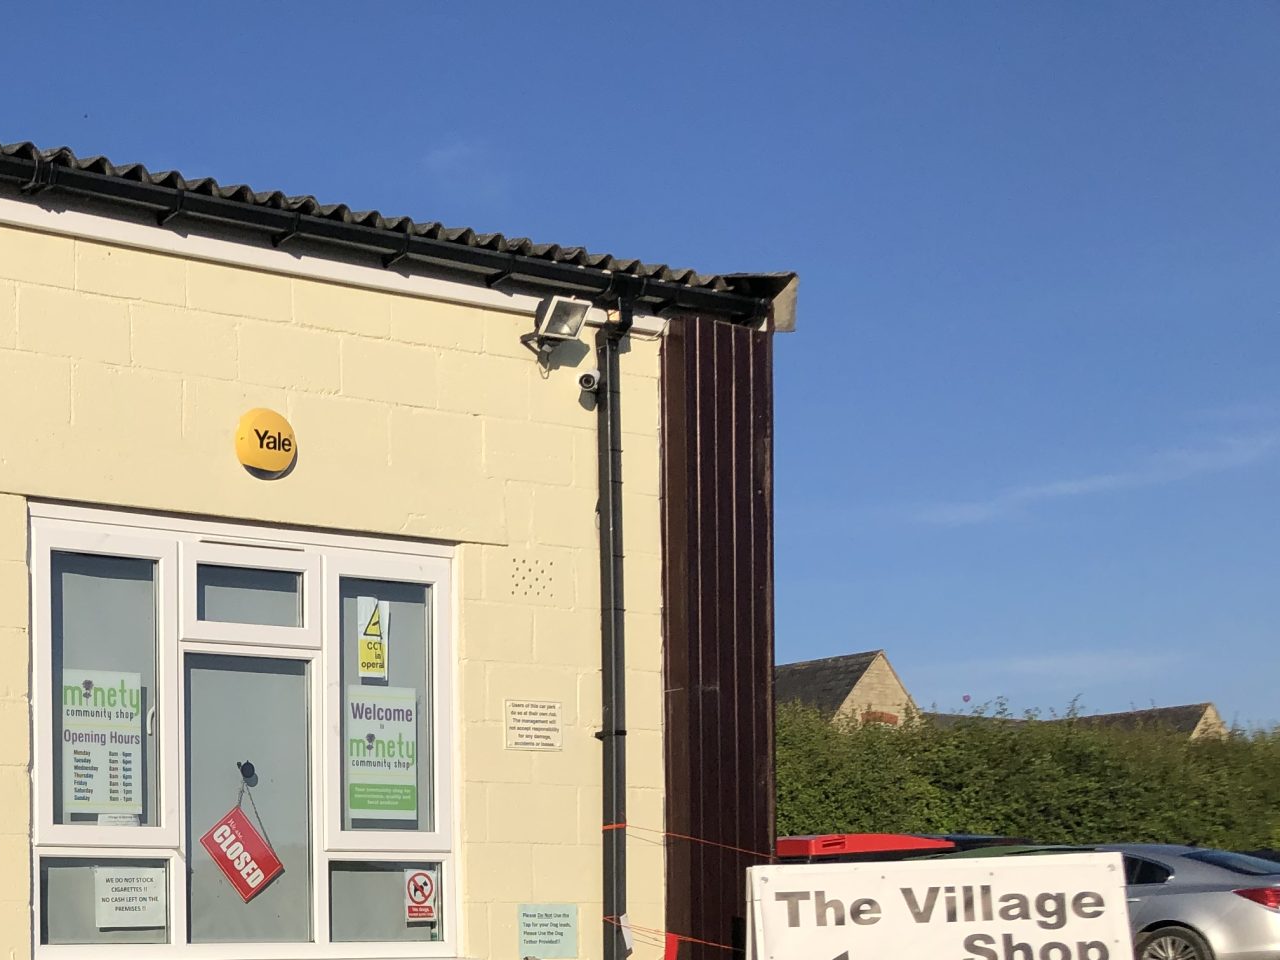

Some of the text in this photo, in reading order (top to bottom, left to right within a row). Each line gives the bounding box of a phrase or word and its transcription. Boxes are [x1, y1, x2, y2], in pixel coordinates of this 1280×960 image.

[254, 428, 292, 452] Yale
[66, 708, 134, 722] community shop
[350, 702, 412, 722] Welcome
[64, 728, 140, 746] Opening Hours
[352, 759, 410, 770] community shop
[74, 772, 94, 780] Thursday
[213, 824, 265, 888] CLOSED
[774, 884, 1105, 930] The Village
